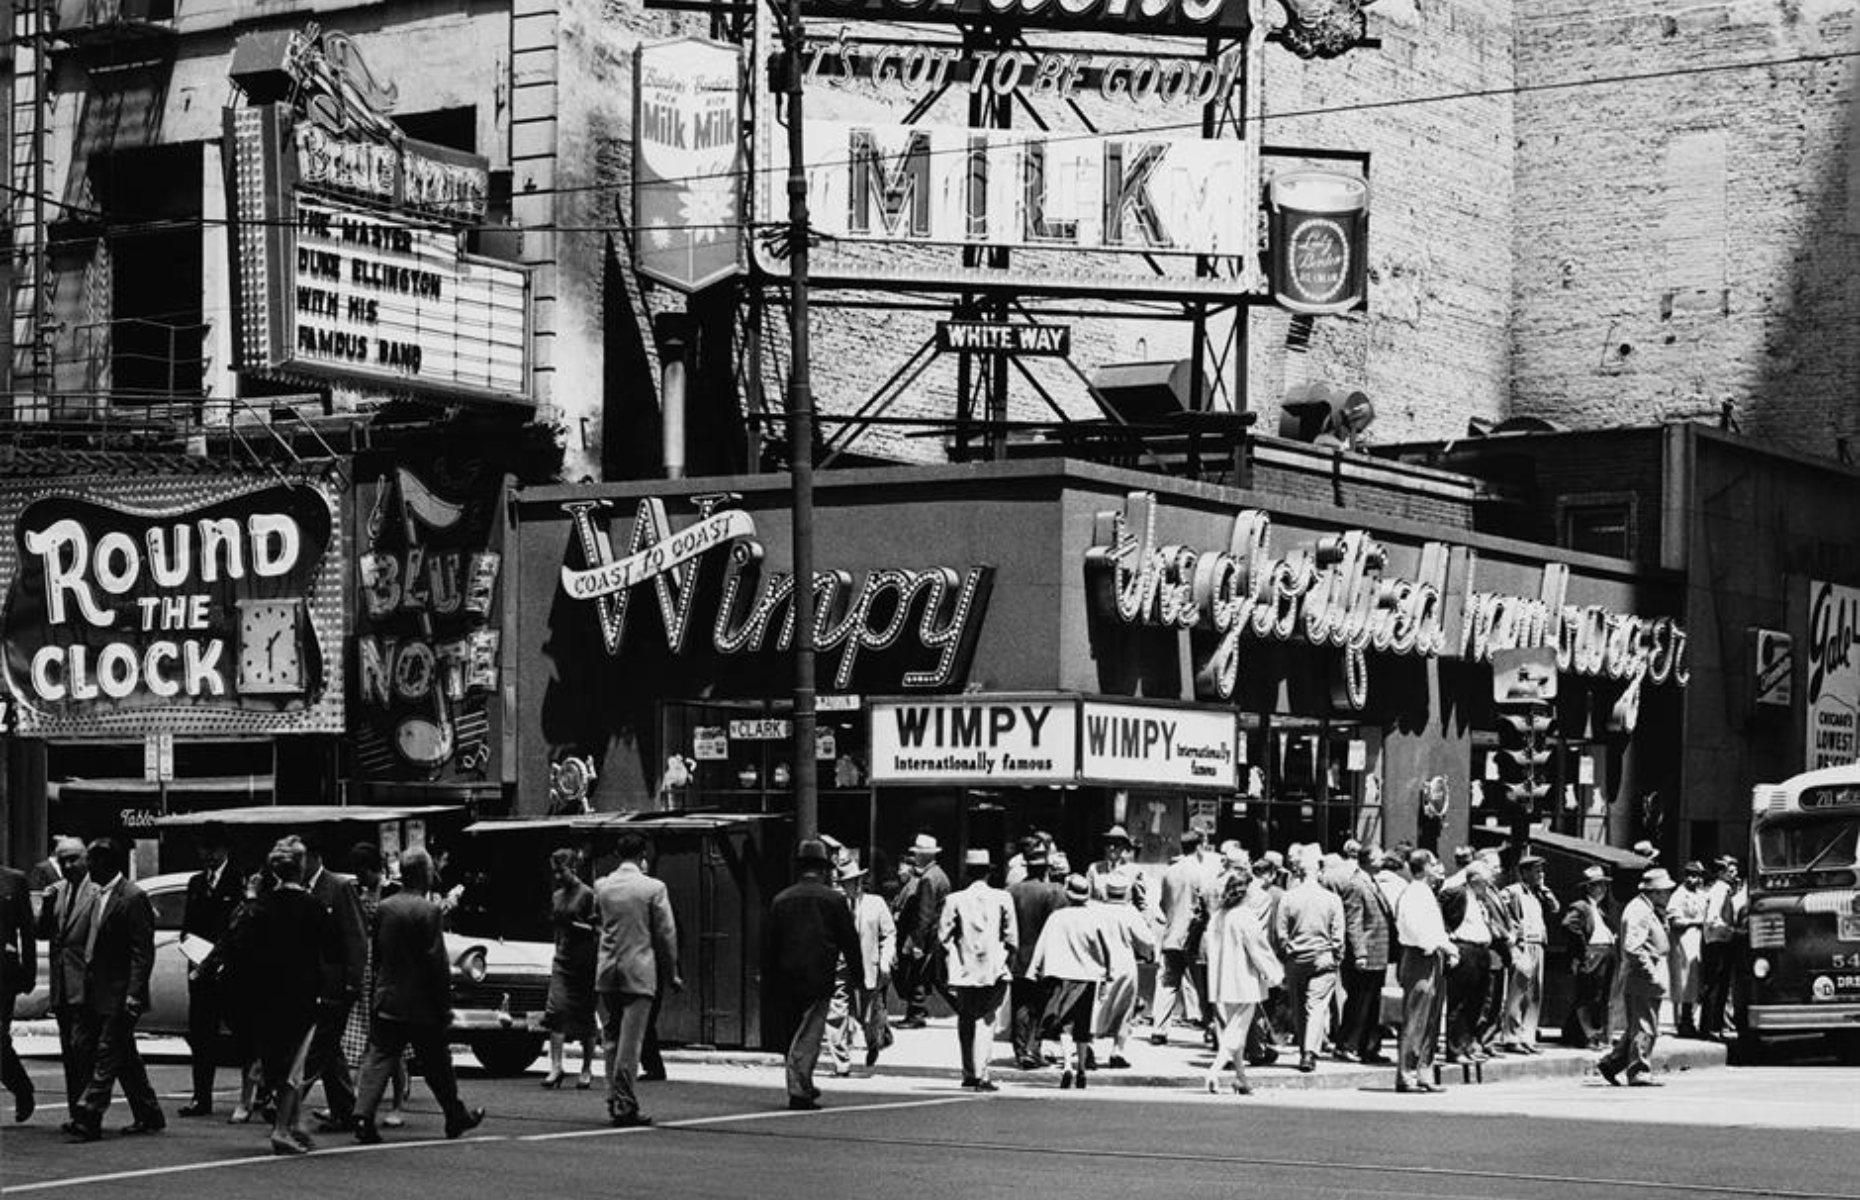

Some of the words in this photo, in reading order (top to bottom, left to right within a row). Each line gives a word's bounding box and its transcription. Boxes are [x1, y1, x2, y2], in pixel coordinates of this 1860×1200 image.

[871, 45, 962, 91] GOT
[970, 50, 1024, 95] TO
[1032, 53, 1093, 99] BE
[642, 101, 686, 150] Milk
[694, 108, 735, 150] Milk
[847, 127, 1174, 250] MILK
[298, 207, 332, 237] THE
[342, 217, 413, 253] MASTER
[298, 247, 341, 283] DUKE
[351, 258, 443, 302] ELLINGTON
[297, 286, 339, 321] WITH
[348, 295, 380, 326] HIS
[298, 325, 368, 361] FAMOUS
[378, 339, 423, 374] BAND
[946, 324, 1014, 348] WHITE
[1018, 327, 1064, 350] WAY
[25, 513, 300, 626] ROUND
[574, 562, 633, 595] COAST
[644, 548, 665, 574] TO
[671, 514, 734, 558] COAST
[359, 549, 500, 617] BLUE
[560, 492, 982, 690] Wimpy
[137, 595, 211, 632] THE
[30, 638, 225, 700] CLOCK
[359, 626, 500, 706] NOTE
[739, 721, 780, 737] CLARK
[895, 705, 1052, 748] WIMPY
[1087, 715, 1177, 761] WIMPY
[894, 751, 995, 775] Internationally
[1002, 753, 1053, 770] famous
